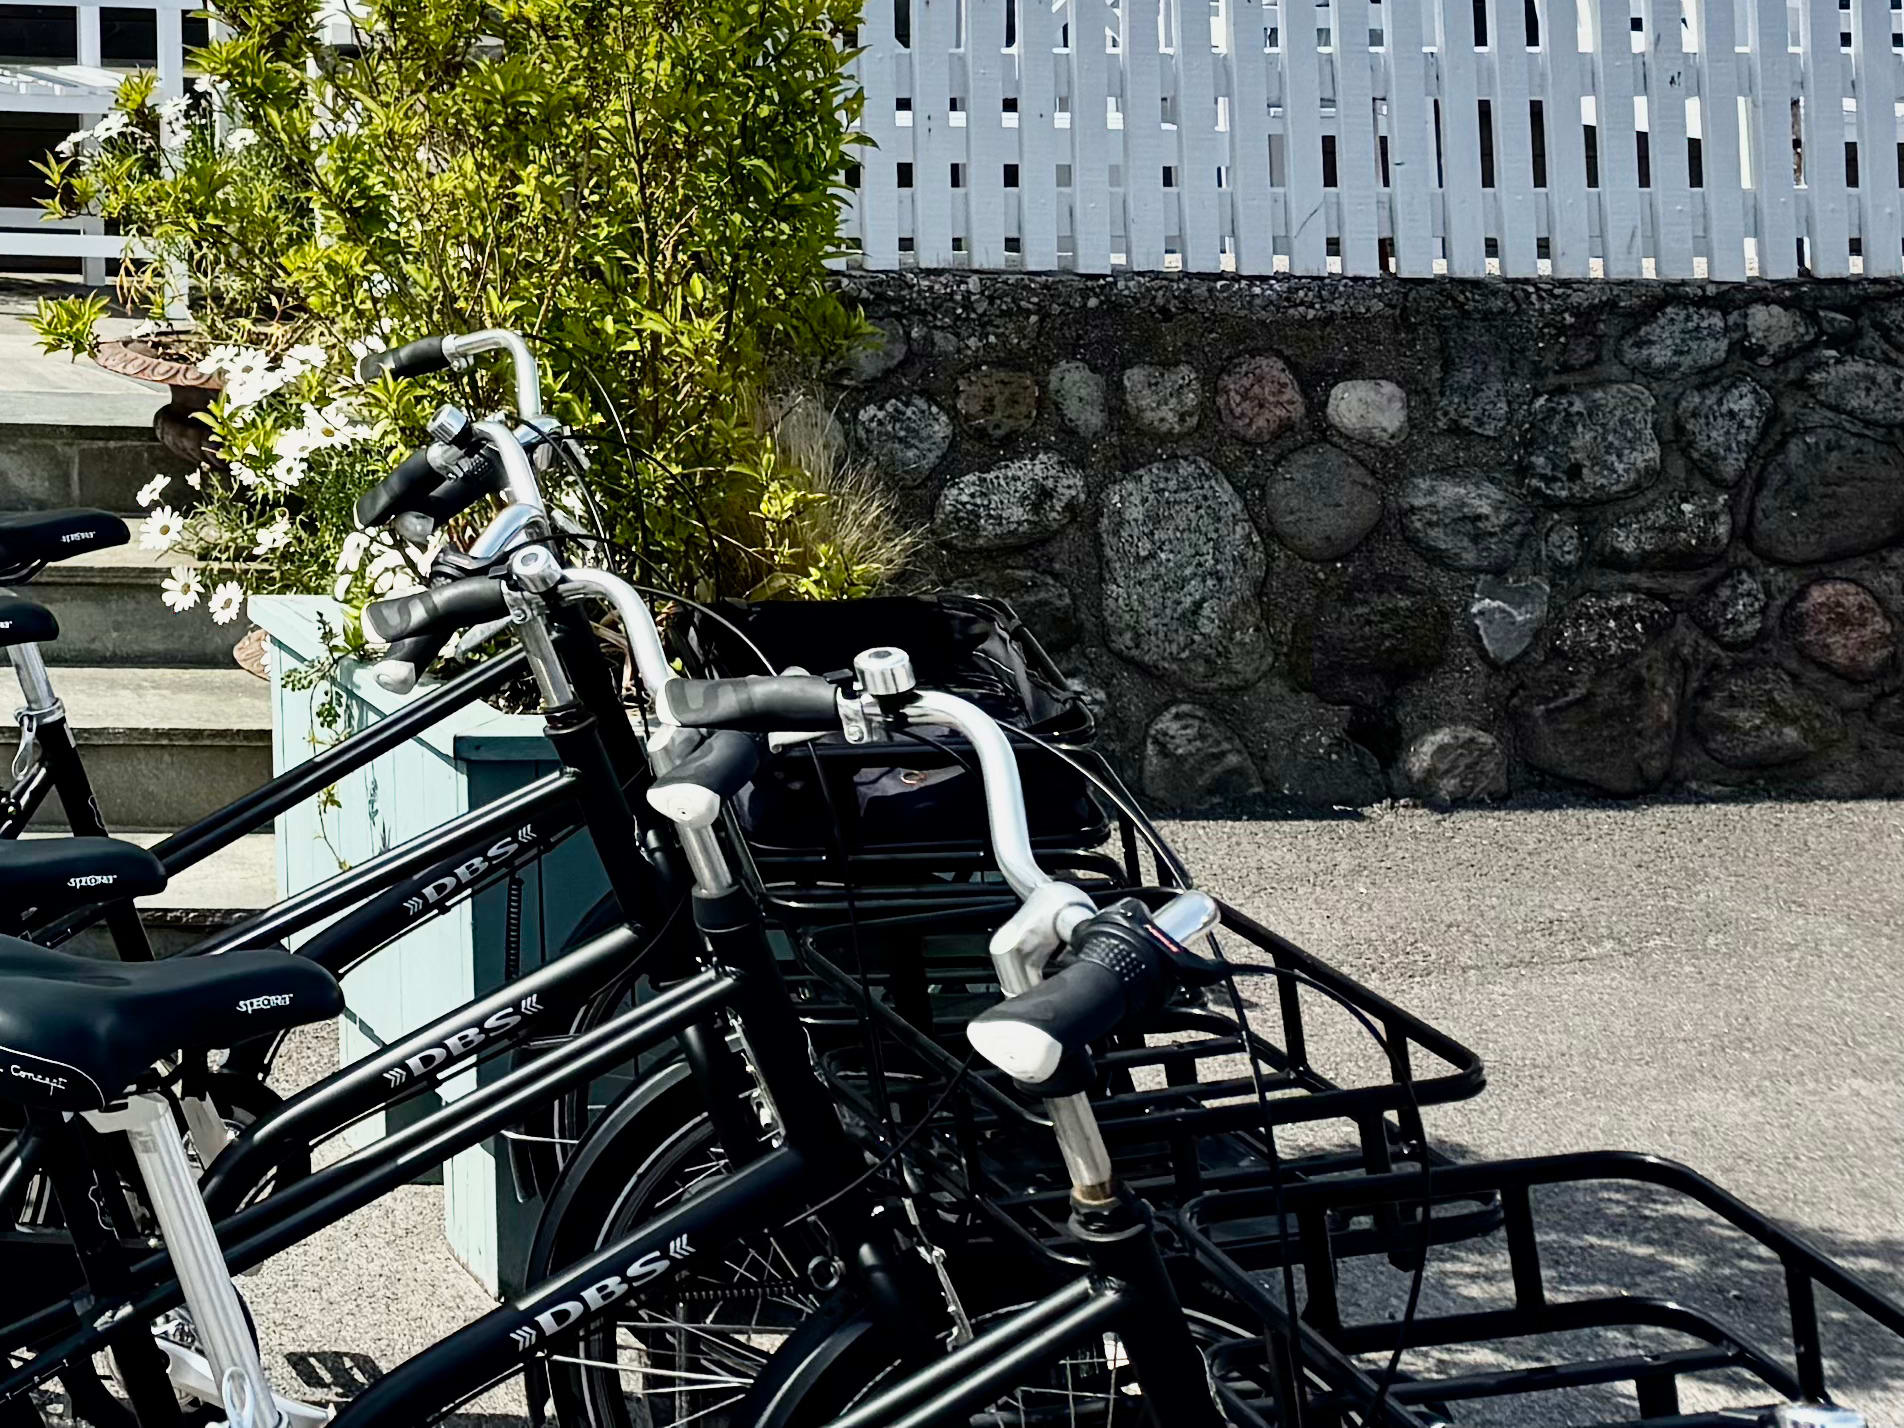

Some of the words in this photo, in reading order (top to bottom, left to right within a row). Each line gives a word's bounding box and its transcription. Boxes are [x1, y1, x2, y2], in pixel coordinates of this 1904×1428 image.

[421, 836, 519, 904] DBS
[405, 1007, 522, 1077] DBS
[10, 1064, 68, 1096] Concept
[534, 1250, 671, 1337] DBS
